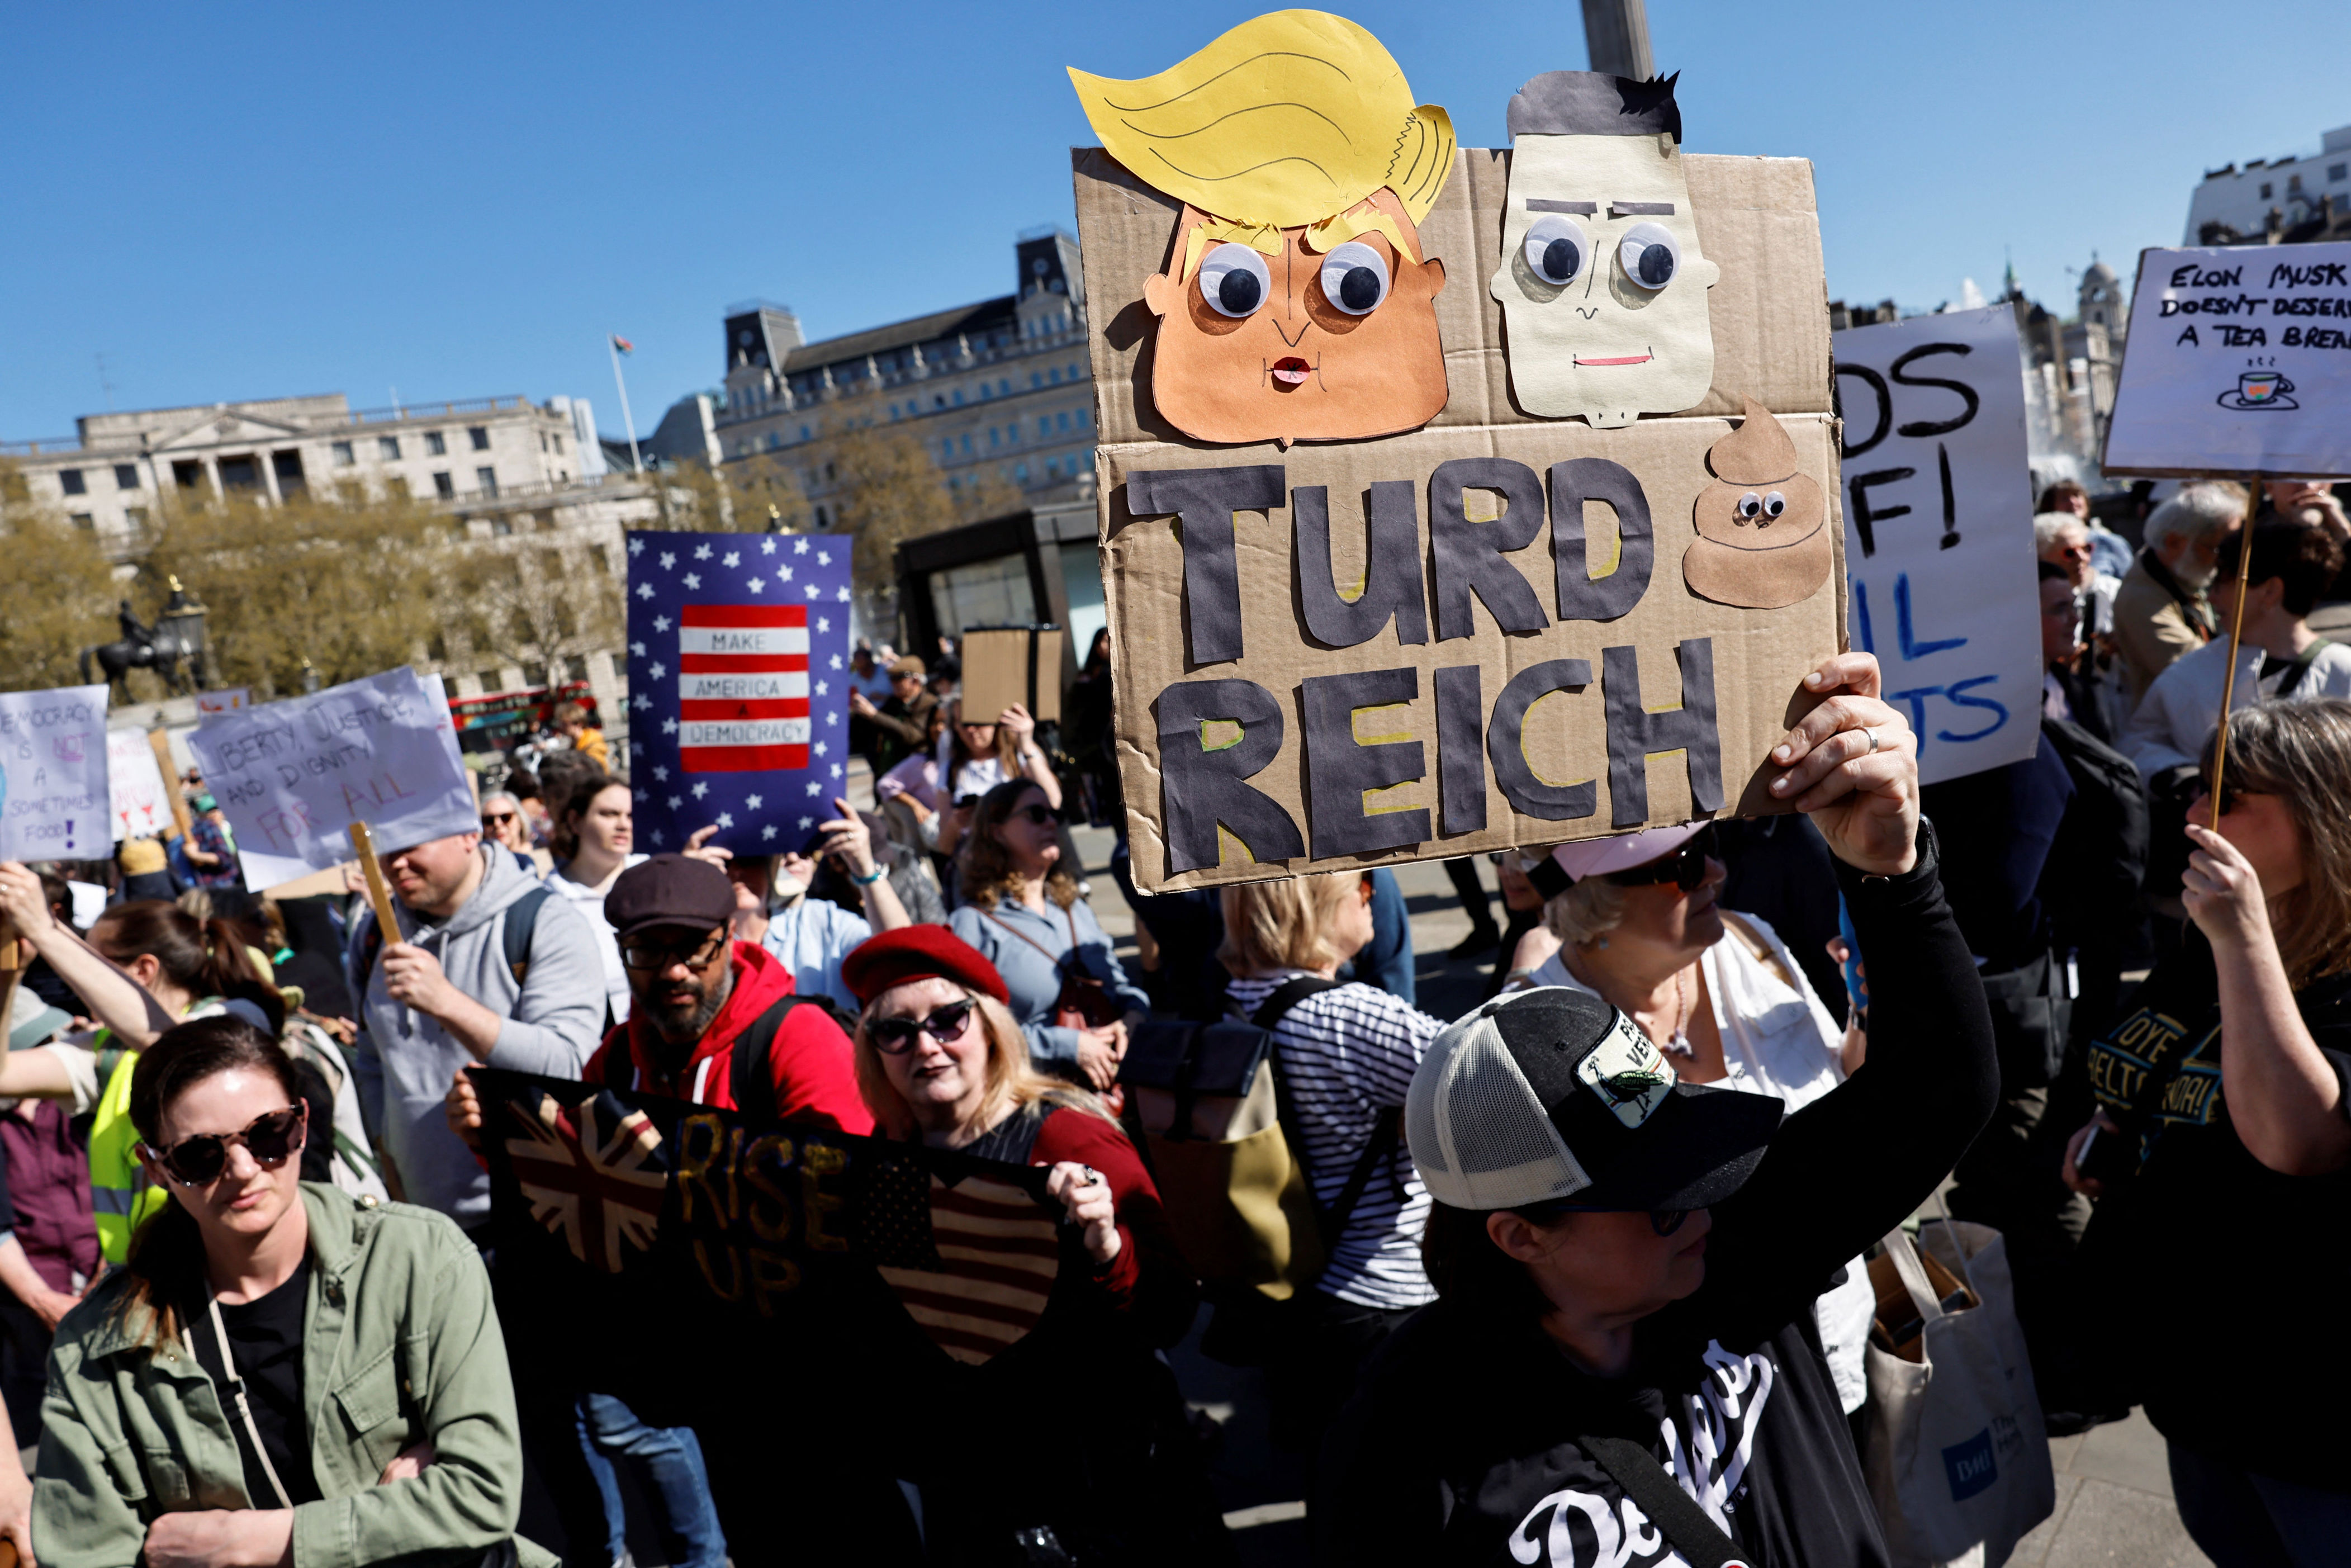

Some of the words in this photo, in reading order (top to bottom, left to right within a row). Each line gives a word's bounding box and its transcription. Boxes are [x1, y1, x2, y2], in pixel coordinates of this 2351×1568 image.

[2170, 264, 2243, 287] ELON
[2268, 263, 2348, 289] MUSK
[2159, 293, 2268, 318] DOESN'T
[2272, 297, 2351, 319] DESER
[2177, 324, 2199, 347] A
[2212, 324, 2267, 347] TEA
[2281, 326, 2351, 349] BREA
[1834, 342, 1980, 459] DS
[1846, 442, 1961, 559] F!
[1126, 457, 1655, 665] TURD
[1847, 570, 1968, 661] IL
[712, 633, 766, 650] MAKE
[695, 678, 781, 697] AMERICA
[738, 703, 750, 717] A
[0, 702, 95, 735] EMOCRACY
[690, 722, 806, 745] DEMOCRACY
[1889, 674, 2010, 760] TS
[17, 740, 33, 761] IS
[225, 778, 265, 807] AND
[277, 741, 371, 789] DIGNITY
[1158, 637, 1726, 873] REICH
[33, 766, 47, 787] A
[255, 800, 323, 850] FOR
[339, 772, 416, 818] ALL
[2118, 1016, 2179, 1063] OYE
[675, 1112, 850, 1252] RISE
[692, 1237, 802, 1318] UP
